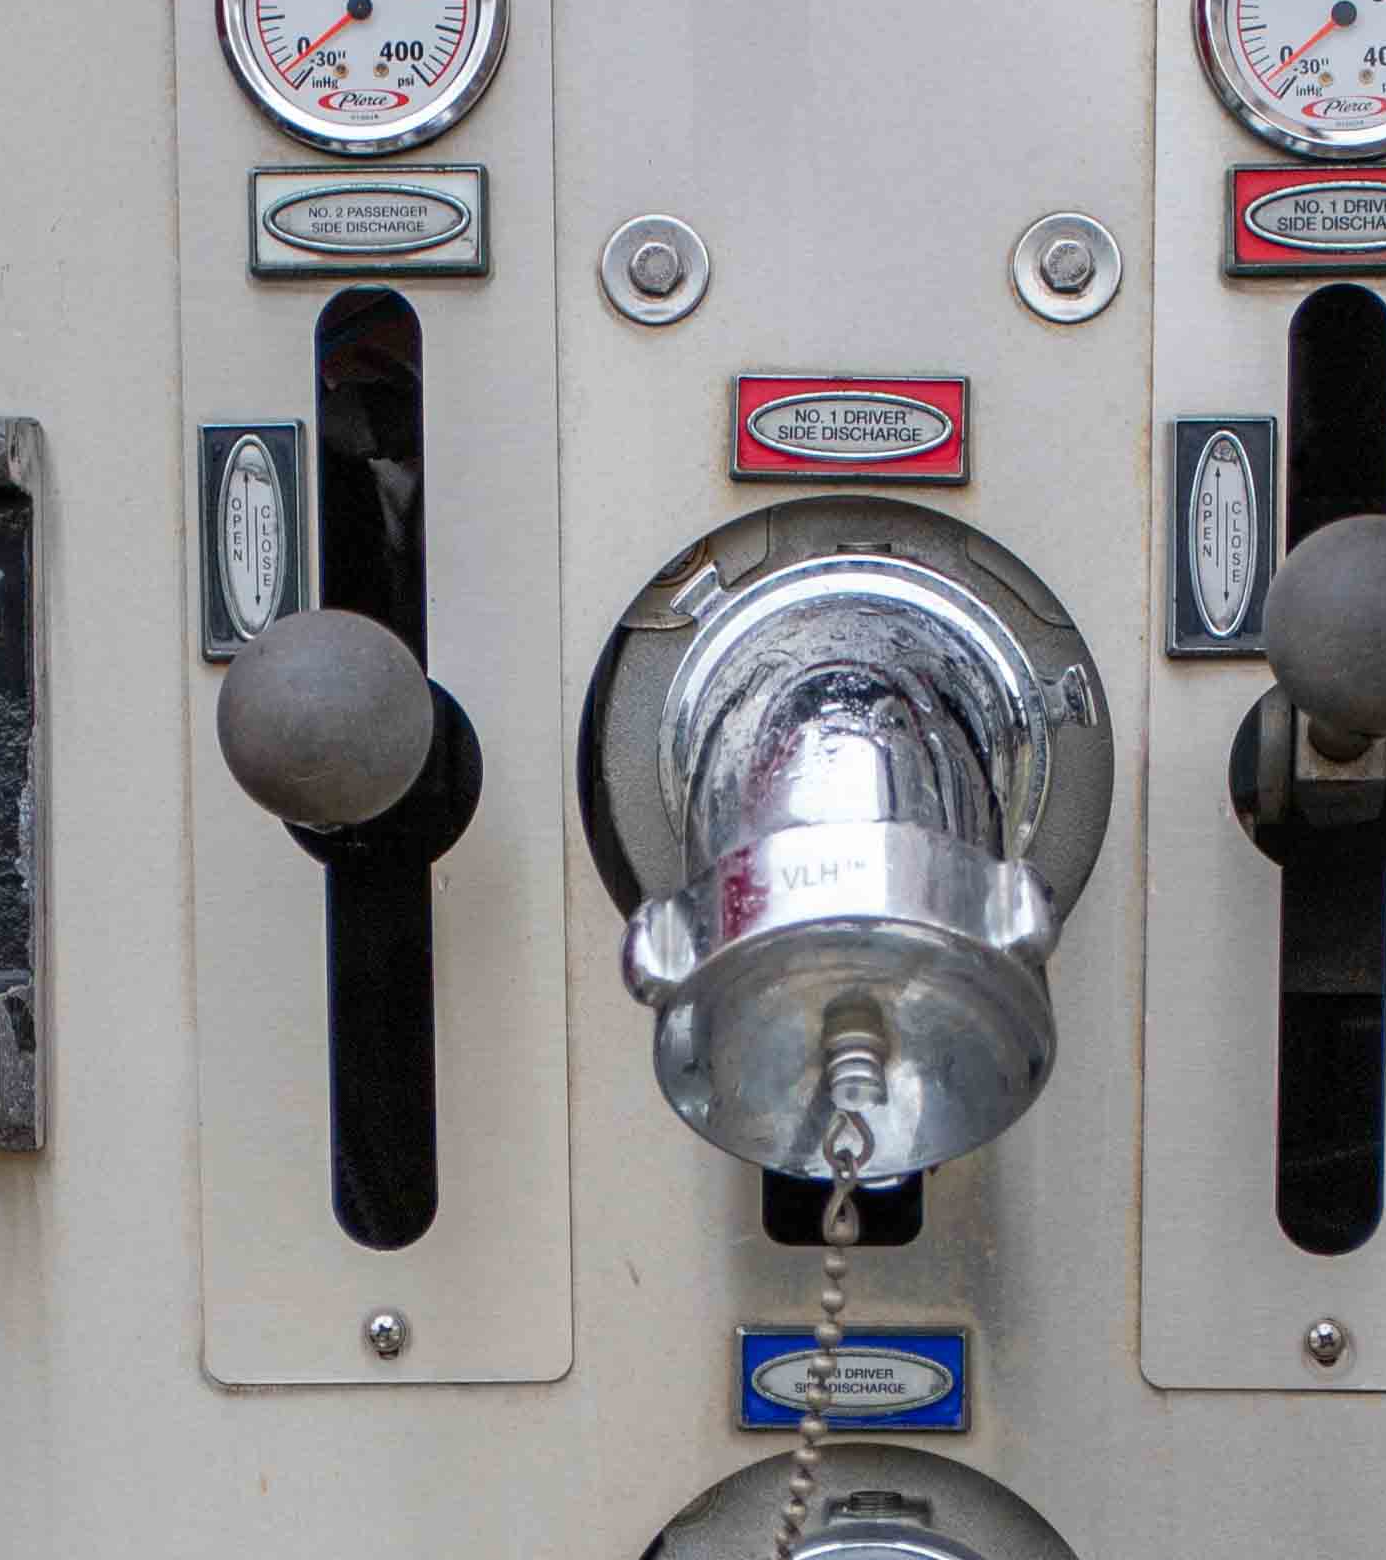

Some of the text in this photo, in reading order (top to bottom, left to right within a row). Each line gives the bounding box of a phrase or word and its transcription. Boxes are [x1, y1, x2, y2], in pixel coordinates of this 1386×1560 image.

[297, 36, 310, 55] 0
[379, 41, 423, 61] 400
[1279, 46, 1294, 64] 0
[397, 76, 415, 88] psi
[339, 91, 387, 109] Pierce
[1323, 99, 1373, 115] Pierce
[308, 205, 428, 218] NO. 2 PASSENGER
[1294, 199, 1324, 214] NO.
[1331, 200, 1337, 214] 1
[311, 220, 426, 234] SIDE DISCHARGE
[1277, 217, 1317, 231] SIDE
[795, 409, 907, 424] NO. 1 DRIVER
[778, 426, 924, 441] SIDE DISCHARGE
[231, 498, 243, 561] OPEN
[1202, 492, 1213, 558] OPEN
[261, 506, 272, 587] CLOSE
[1231, 501, 1242, 584] CLOSE
[844, 1368, 894, 1379] DRIVER
[829, 1383, 907, 1394] DISCHARGE
